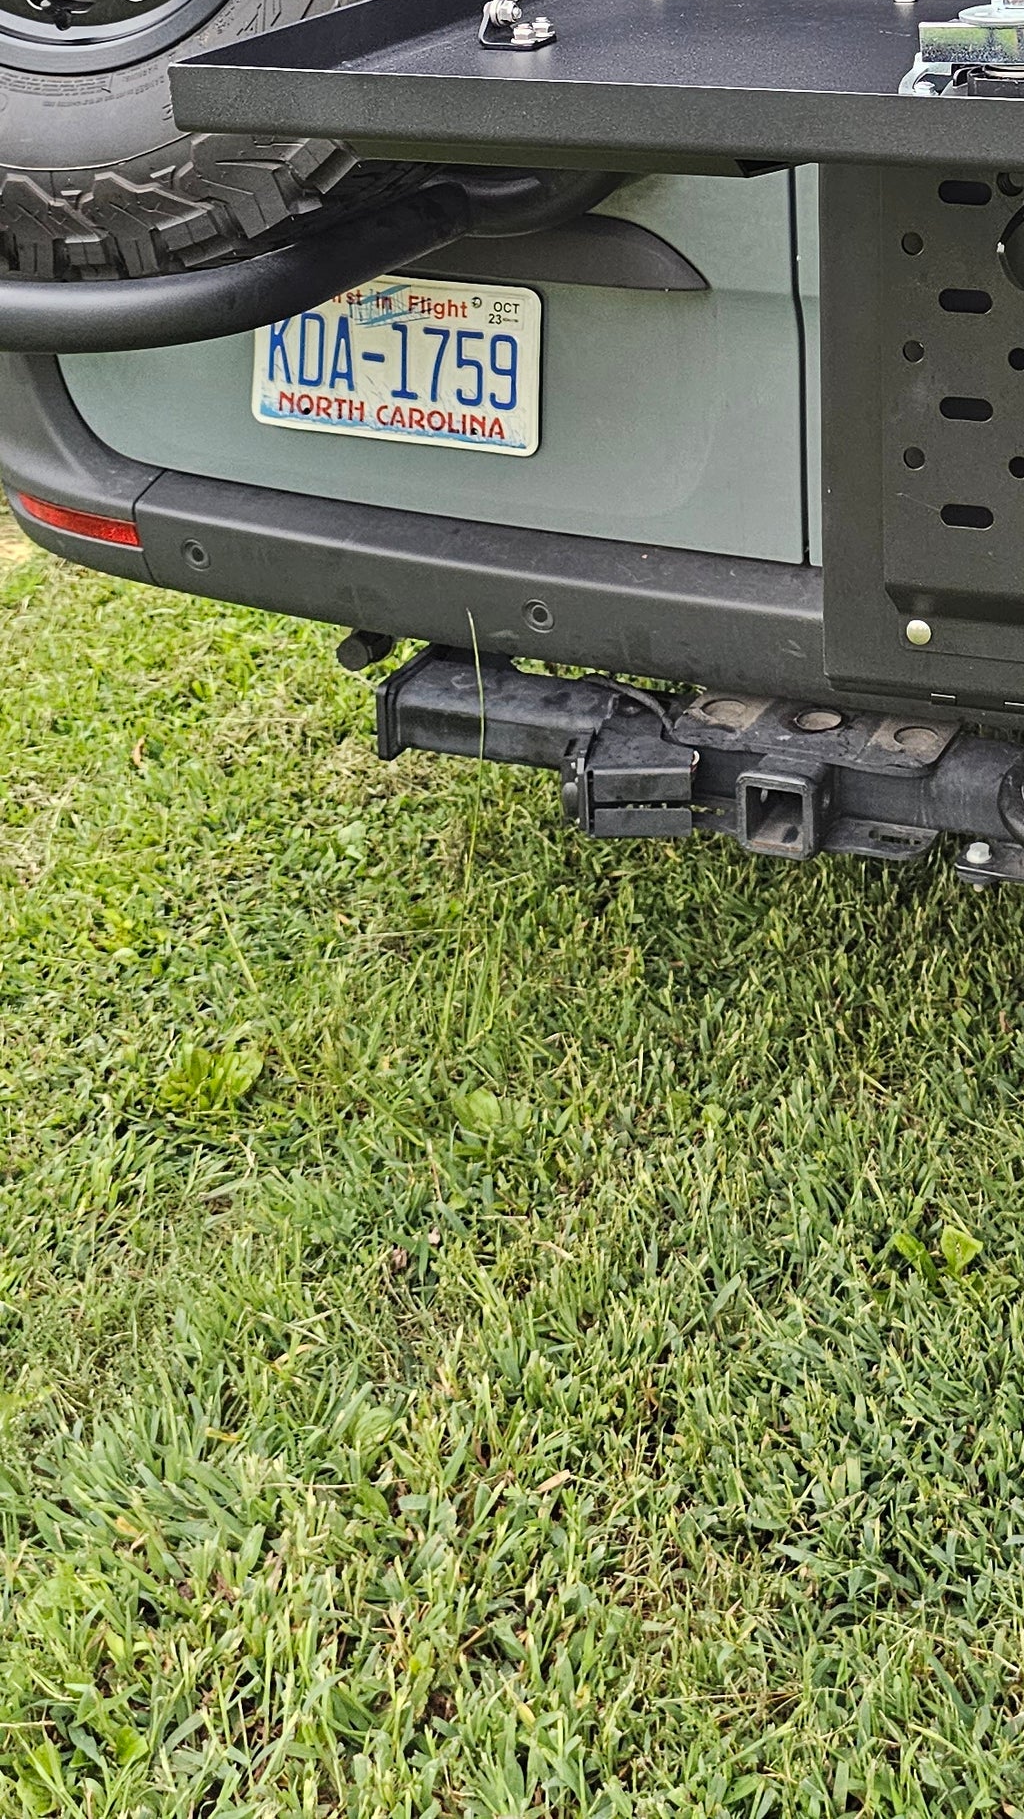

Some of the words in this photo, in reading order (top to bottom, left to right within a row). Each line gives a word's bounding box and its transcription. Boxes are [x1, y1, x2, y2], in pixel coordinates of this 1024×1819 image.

[376, 291, 392, 311] in
[408, 295, 468, 320] Flight
[488, 313, 502, 325] 23
[493, 301, 520, 314] OCT
[268, 312, 518, 411] KDA-1759
[278, 391, 365, 422] NORTH
[376, 405, 506, 440] CAROLINA
